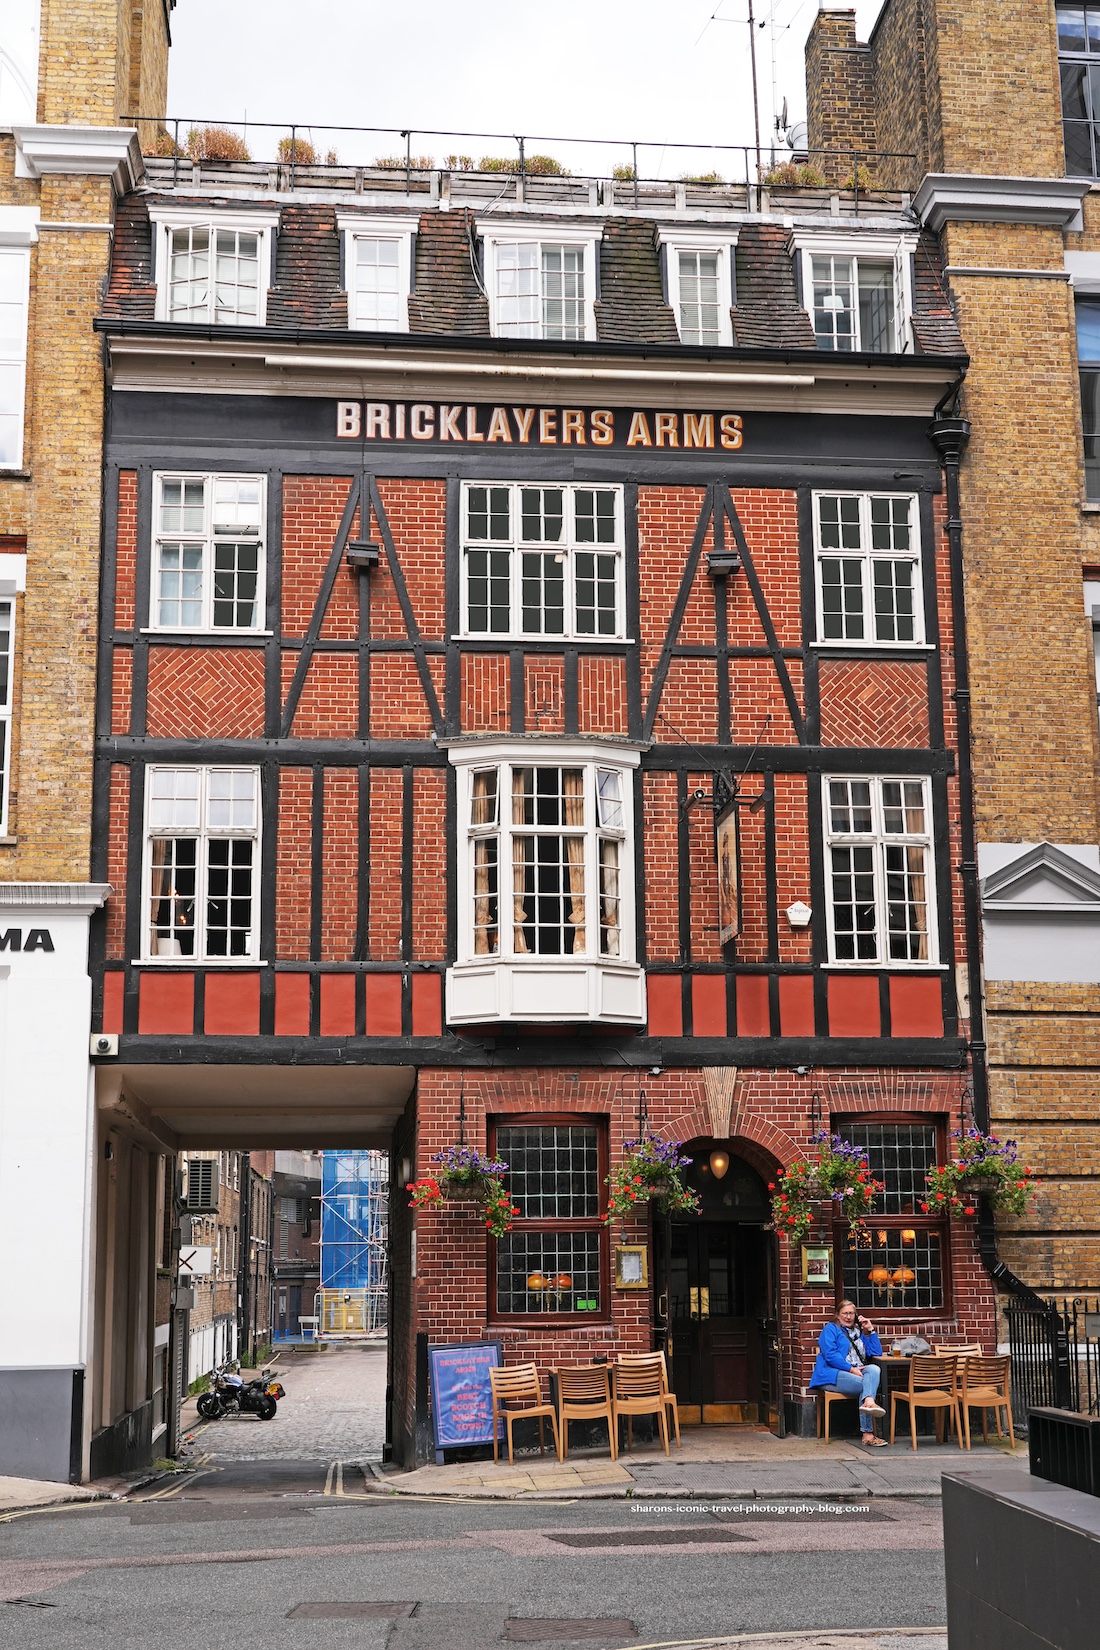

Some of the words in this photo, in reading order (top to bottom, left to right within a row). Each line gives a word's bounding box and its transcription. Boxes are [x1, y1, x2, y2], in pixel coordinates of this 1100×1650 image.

[336, 401, 615, 445] BRICKLAYERS
[626, 411, 744, 450] ARMS
[440, 1356, 490, 1367] BRICKLAYERS
[457, 1392, 479, 1401] BEST
[451, 1402, 487, 1412] SCOTCH
